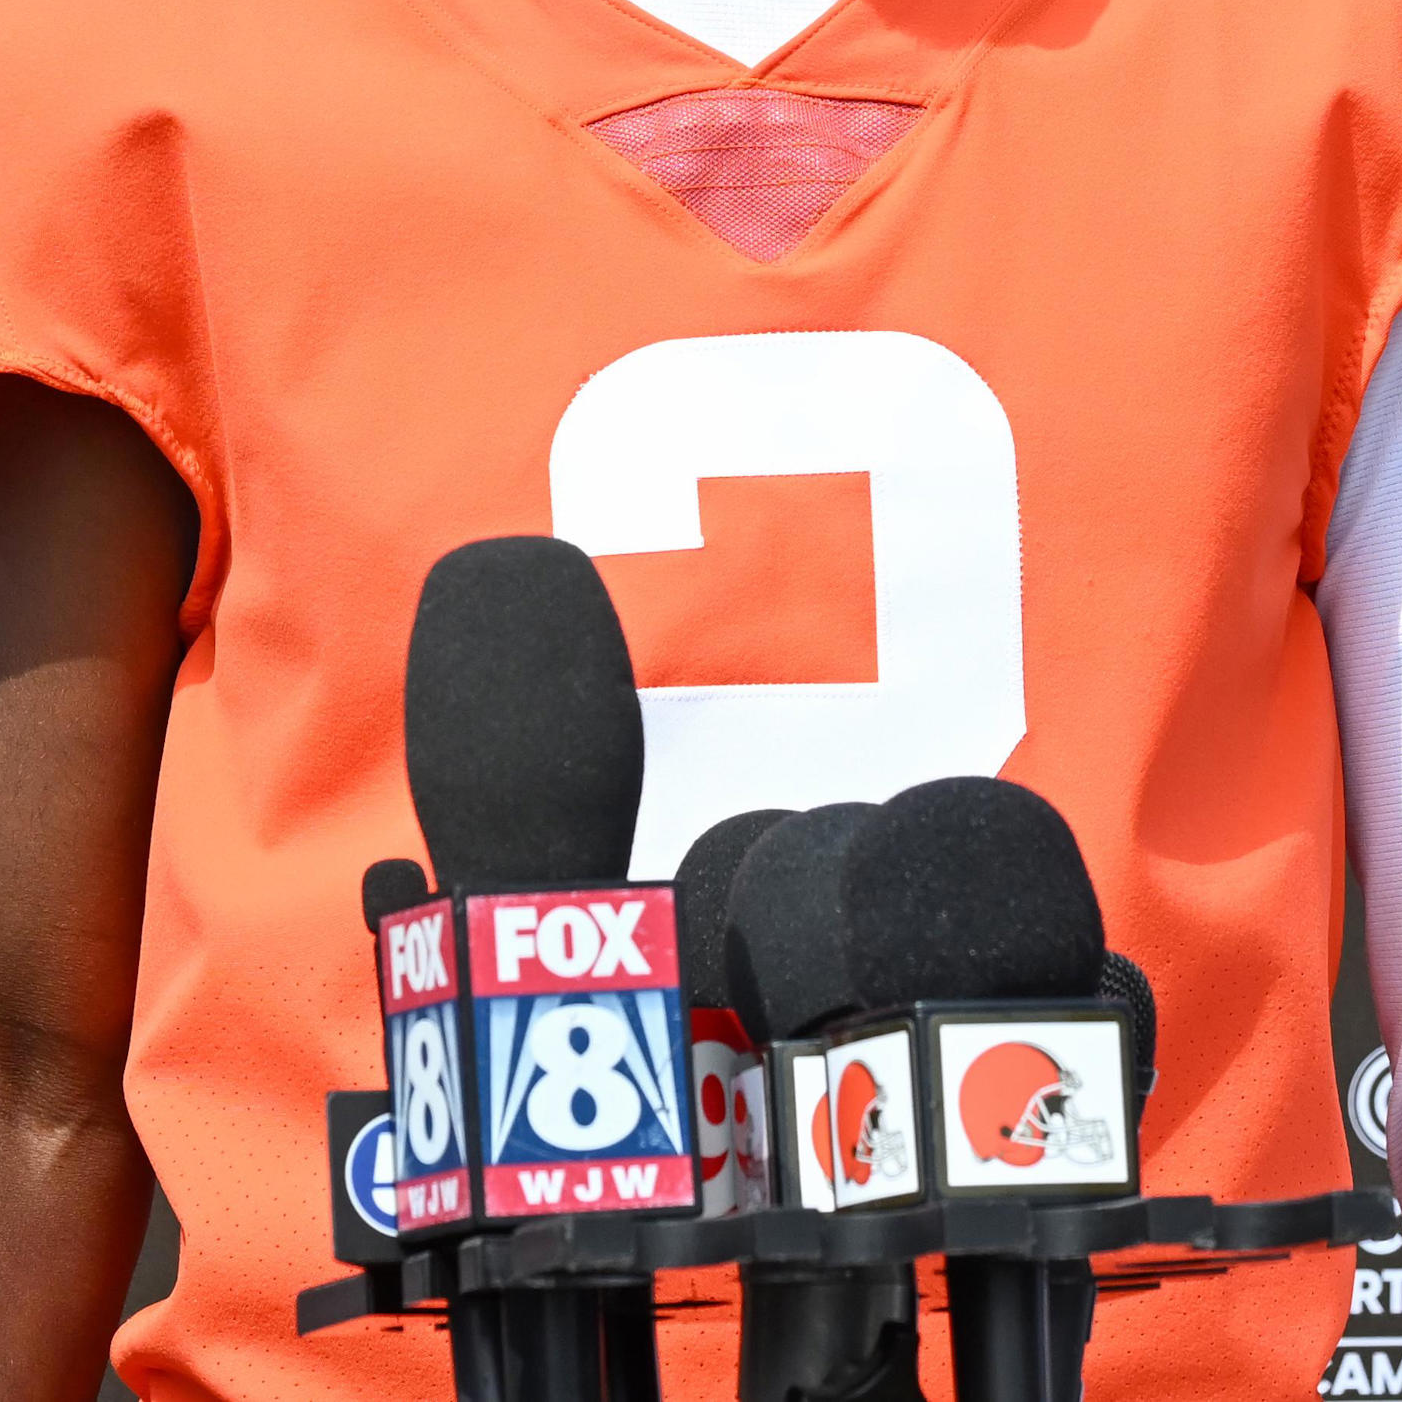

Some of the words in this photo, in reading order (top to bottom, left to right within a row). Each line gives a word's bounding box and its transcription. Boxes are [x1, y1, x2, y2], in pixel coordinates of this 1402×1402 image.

[388, 912, 448, 1000] FOX
[493, 900, 653, 983] FOX
[405, 1019, 450, 1165] 8
[526, 1002, 642, 1152] 8
